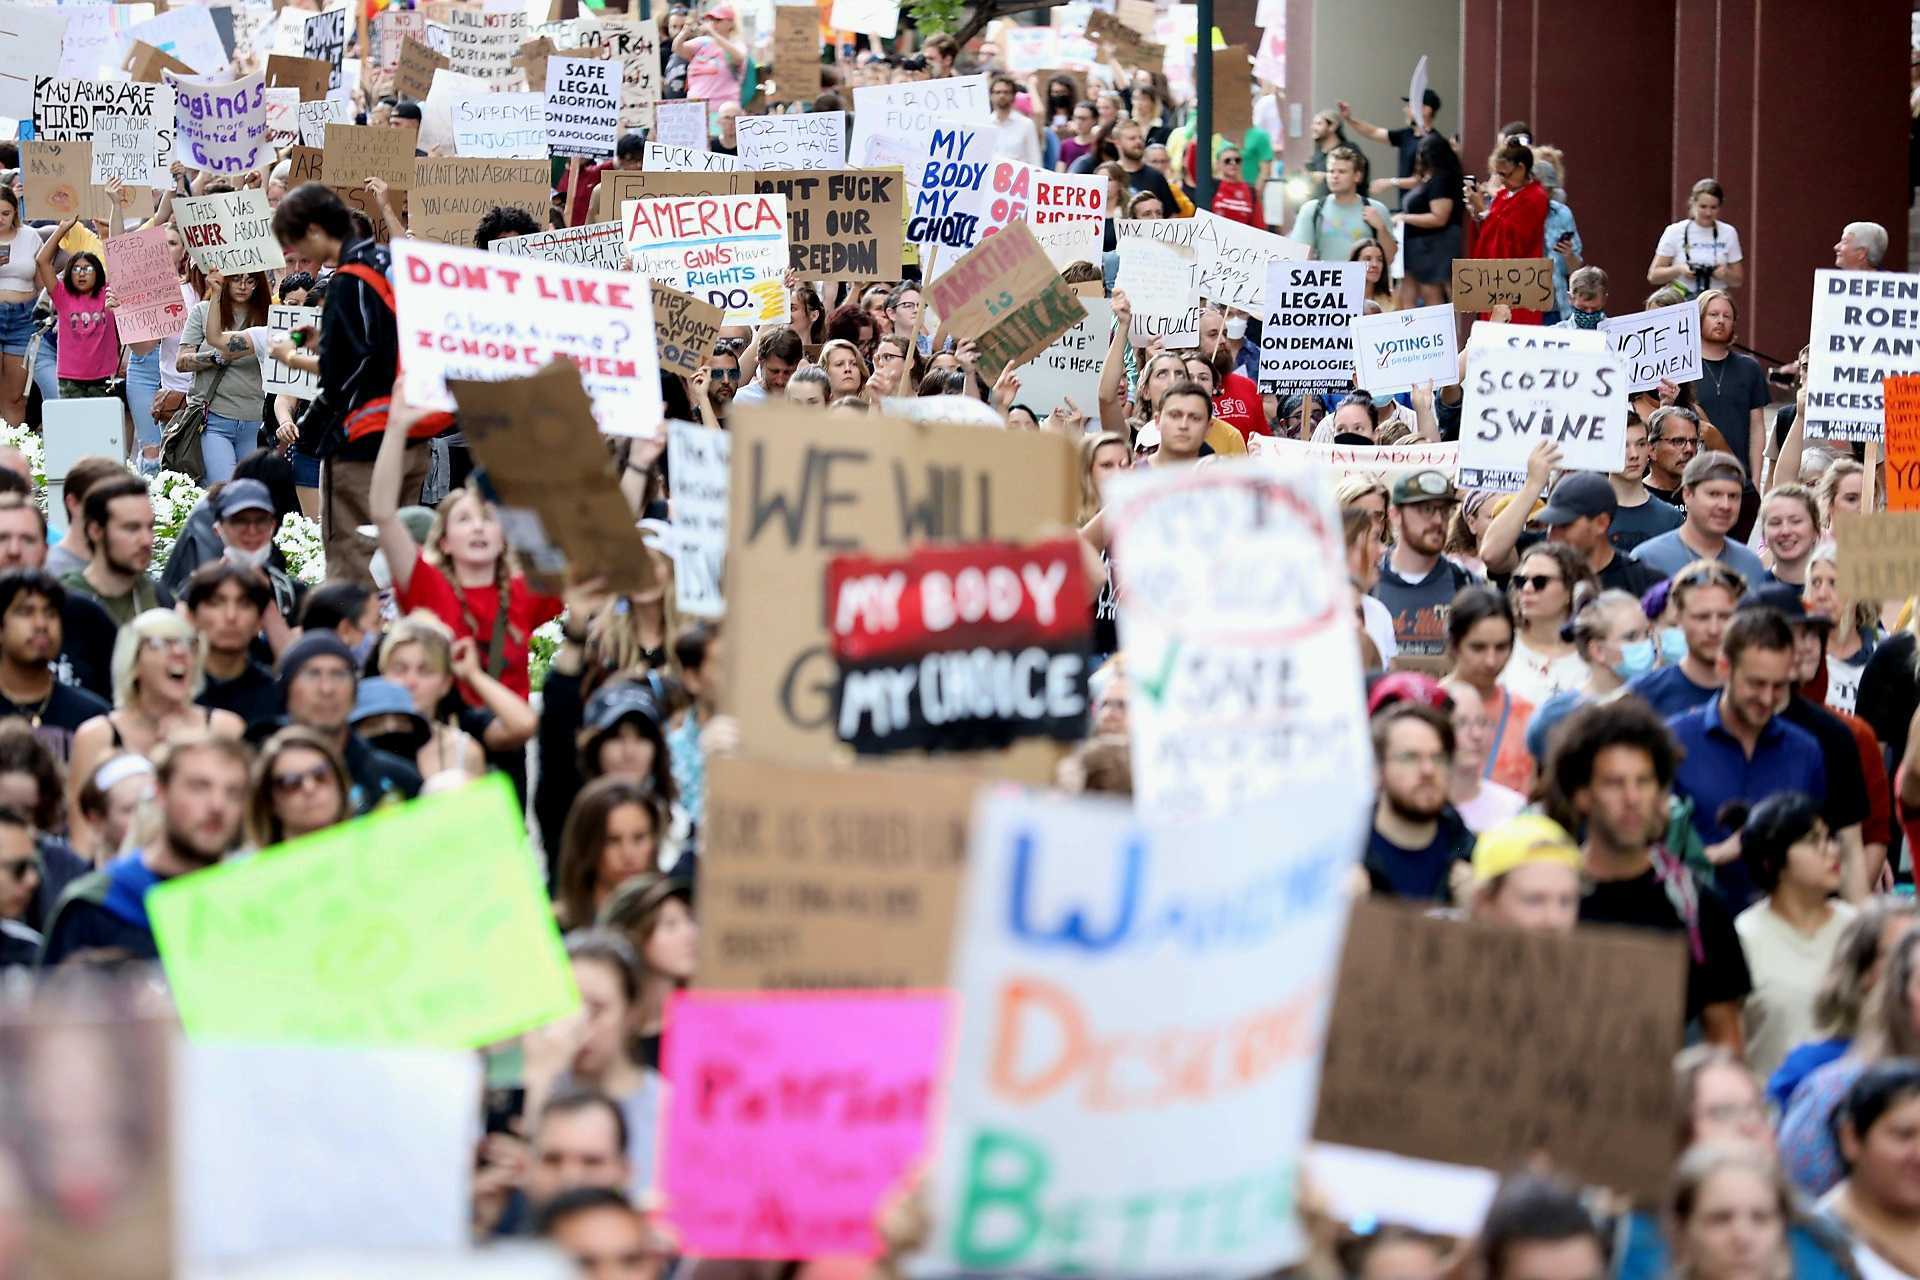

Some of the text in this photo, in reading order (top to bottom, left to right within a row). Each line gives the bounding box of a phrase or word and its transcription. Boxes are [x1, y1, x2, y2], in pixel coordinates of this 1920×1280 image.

[306, 11, 345, 49] CHOKE
[484, 14, 508, 28] NOT
[510, 12, 528, 28] BE
[452, 32, 478, 44] TOLD
[565, 63, 605, 79] SAFE
[46, 79, 156, 104] MY ARMS ARE
[559, 80, 609, 96] LEGAL
[886, 84, 978, 111] ABORT
[461, 101, 543, 121] SUPREME
[549, 94, 617, 110] ABORTION
[42, 104, 89, 130] TIRED
[95, 116, 150, 131] NOT YOUR
[545, 112, 618, 127] ON DEMAND
[783, 117, 838, 137] THOSE
[111, 133, 139, 150] PUSSY
[558, 130, 614, 142] APOLOGIES
[930, 128, 975, 162] MY
[191, 142, 258, 172] Guns
[652, 144, 734, 172] FUCK YOU
[742, 139, 839, 158] WHO HAVE
[96, 153, 146, 169] NOT YOUR
[802, 158, 827, 169] BC
[100, 167, 148, 181] PROBLEM
[455, 165, 479, 186] BAN
[481, 163, 550, 186] ABORTION
[922, 161, 989, 191] BODY
[828, 174, 894, 203] FUCK
[1036, 182, 1101, 210] REPRO
[186, 196, 255, 223] THIS WAS
[421, 198, 441, 216] YOU
[443, 198, 469, 214] CAN
[915, 190, 958, 216] MY
[628, 197, 783, 242] AMERICA
[826, 208, 872, 236] OUR
[906, 211, 980, 248] CHOICE
[1118, 223, 1143, 238] MY
[183, 218, 272, 248] NEVER ABOUT
[496, 221, 623, 255] OUR GOVERNMENT
[684, 243, 732, 269] GUNS
[734, 246, 770, 262] have
[789, 239, 878, 275] REEDOM
[687, 266, 756, 288] RIGHTS
[1290, 269, 1342, 287] SAFE
[536, 275, 634, 309] LIKE
[1828, 277, 1919, 300] DEFEN
[651, 287, 692, 316] THEY
[1281, 292, 1348, 309] LEGAL
[271, 310, 300, 331] IF
[1844, 306, 1919, 329] ROE!
[656, 320, 709, 351] TOP AT
[1678, 317, 1690, 346] 4
[1262, 337, 1353, 350] ON DEMAN
[1374, 333, 1444, 354] VOTING IS
[1829, 335, 1865, 353] BY
[659, 342, 700, 371] OE
[1048, 355, 1104, 373] US HERE
[1260, 360, 1355, 371] NO APOLOGIES
[1422, 350, 1445, 361] power
[1275, 387, 1290, 395] AND
[1276, 380, 1348, 388] PARTY FOR SOCIALISM
[1808, 392, 1885, 410] NECESS
[1828, 420, 1858, 432] PARTY
[1848, 432, 1884, 443] LIBERAT
[1889, 459, 1920, 491] YO
[746, 437, 871, 552] WE
[835, 558, 1068, 637] MY BODY
[837, 646, 1087, 740] MY CHOICE
[985, 975, 1328, 1115] DESERV
